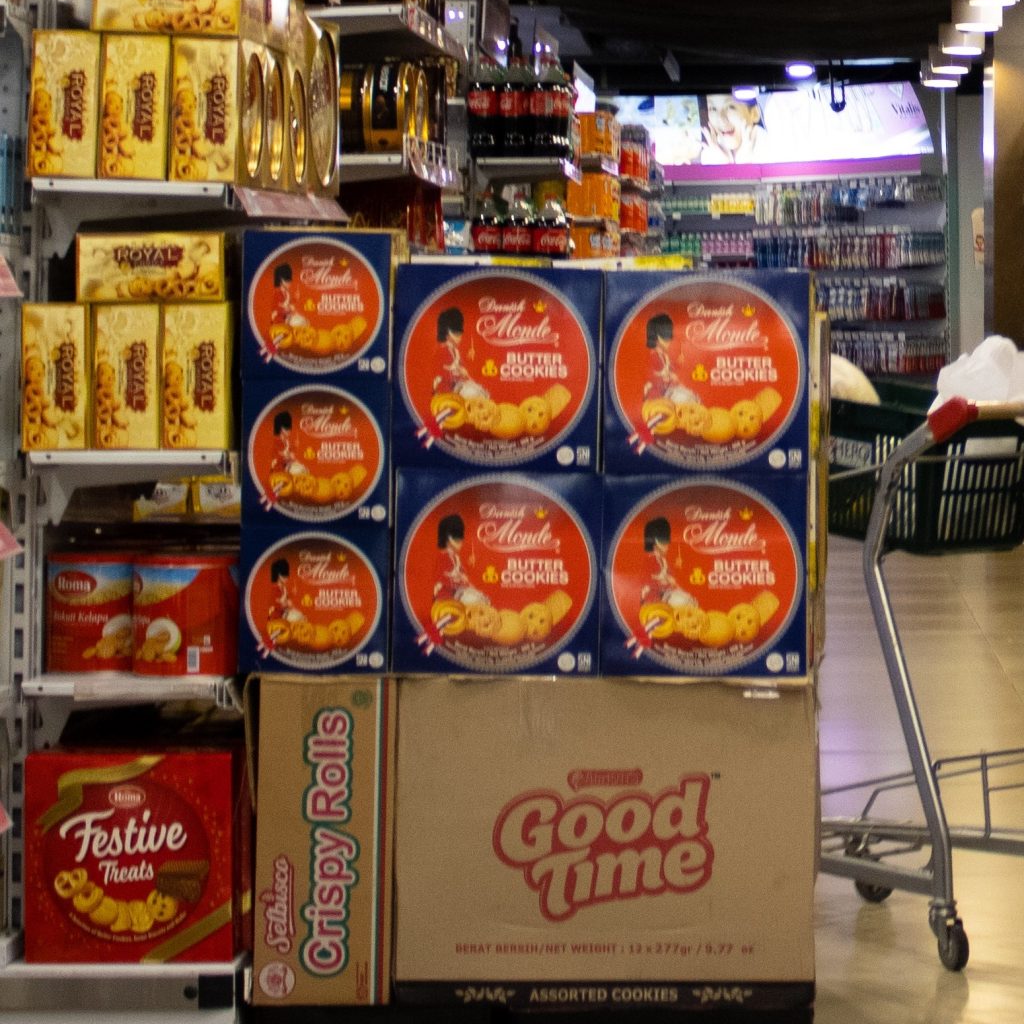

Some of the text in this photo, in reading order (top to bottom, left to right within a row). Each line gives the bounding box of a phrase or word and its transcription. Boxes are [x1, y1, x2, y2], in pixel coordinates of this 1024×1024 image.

[70, 72, 84, 136] ROYAL
[140, 74, 153, 138] ROYAL
[212, 75, 226, 141] ROYAL
[117, 247, 178, 261] ROYAL
[321, 293, 361, 304] BUTTER
[477, 296, 526, 313] Danish
[317, 302, 364, 313] COOKIES
[686, 303, 734, 319] Danish
[506, 351, 563, 366] BUTTER
[716, 356, 772, 369] BUTTER
[61, 343, 74, 409] ROYAL
[132, 343, 146, 409] ROYAL
[201, 343, 214, 409] ROYAL
[500, 364, 569, 379] COOKIES
[709, 367, 778, 383] COOKIES
[321, 441, 360, 452] BUTTER
[317, 450, 364, 461] COOKIES
[478, 502, 526, 519] Danish
[684, 505, 731, 522] Danish
[507, 558, 564, 572] BUTTER
[713, 559, 770, 573] BUTTER
[58, 576, 91, 593] Roma
[500, 571, 569, 586] COOKIES
[707, 571, 776, 587] COOKIES
[318, 588, 359, 599] BUTTER
[314, 597, 362, 609] COOKIES
[78, 610, 109, 626] Kelapa
[304, 708, 353, 827] Rolls
[113, 792, 142, 804] Roma
[494, 772, 712, 868] Good
[60, 809, 188, 863] Festive
[98, 860, 155, 886] Treats
[526, 842, 714, 921] Time
[303, 828, 359, 977] Crispy
[455, 943, 491, 955] BERAT
[496, 943, 567, 955] BERSIH/NET
[571, 943, 617, 955] WEIGHT
[629, 943, 643, 955] 12
[655, 943, 692, 957] 277gr
[705, 943, 734, 956] 9.77
[530, 988, 678, 1002] ASSORTED COOKIES
